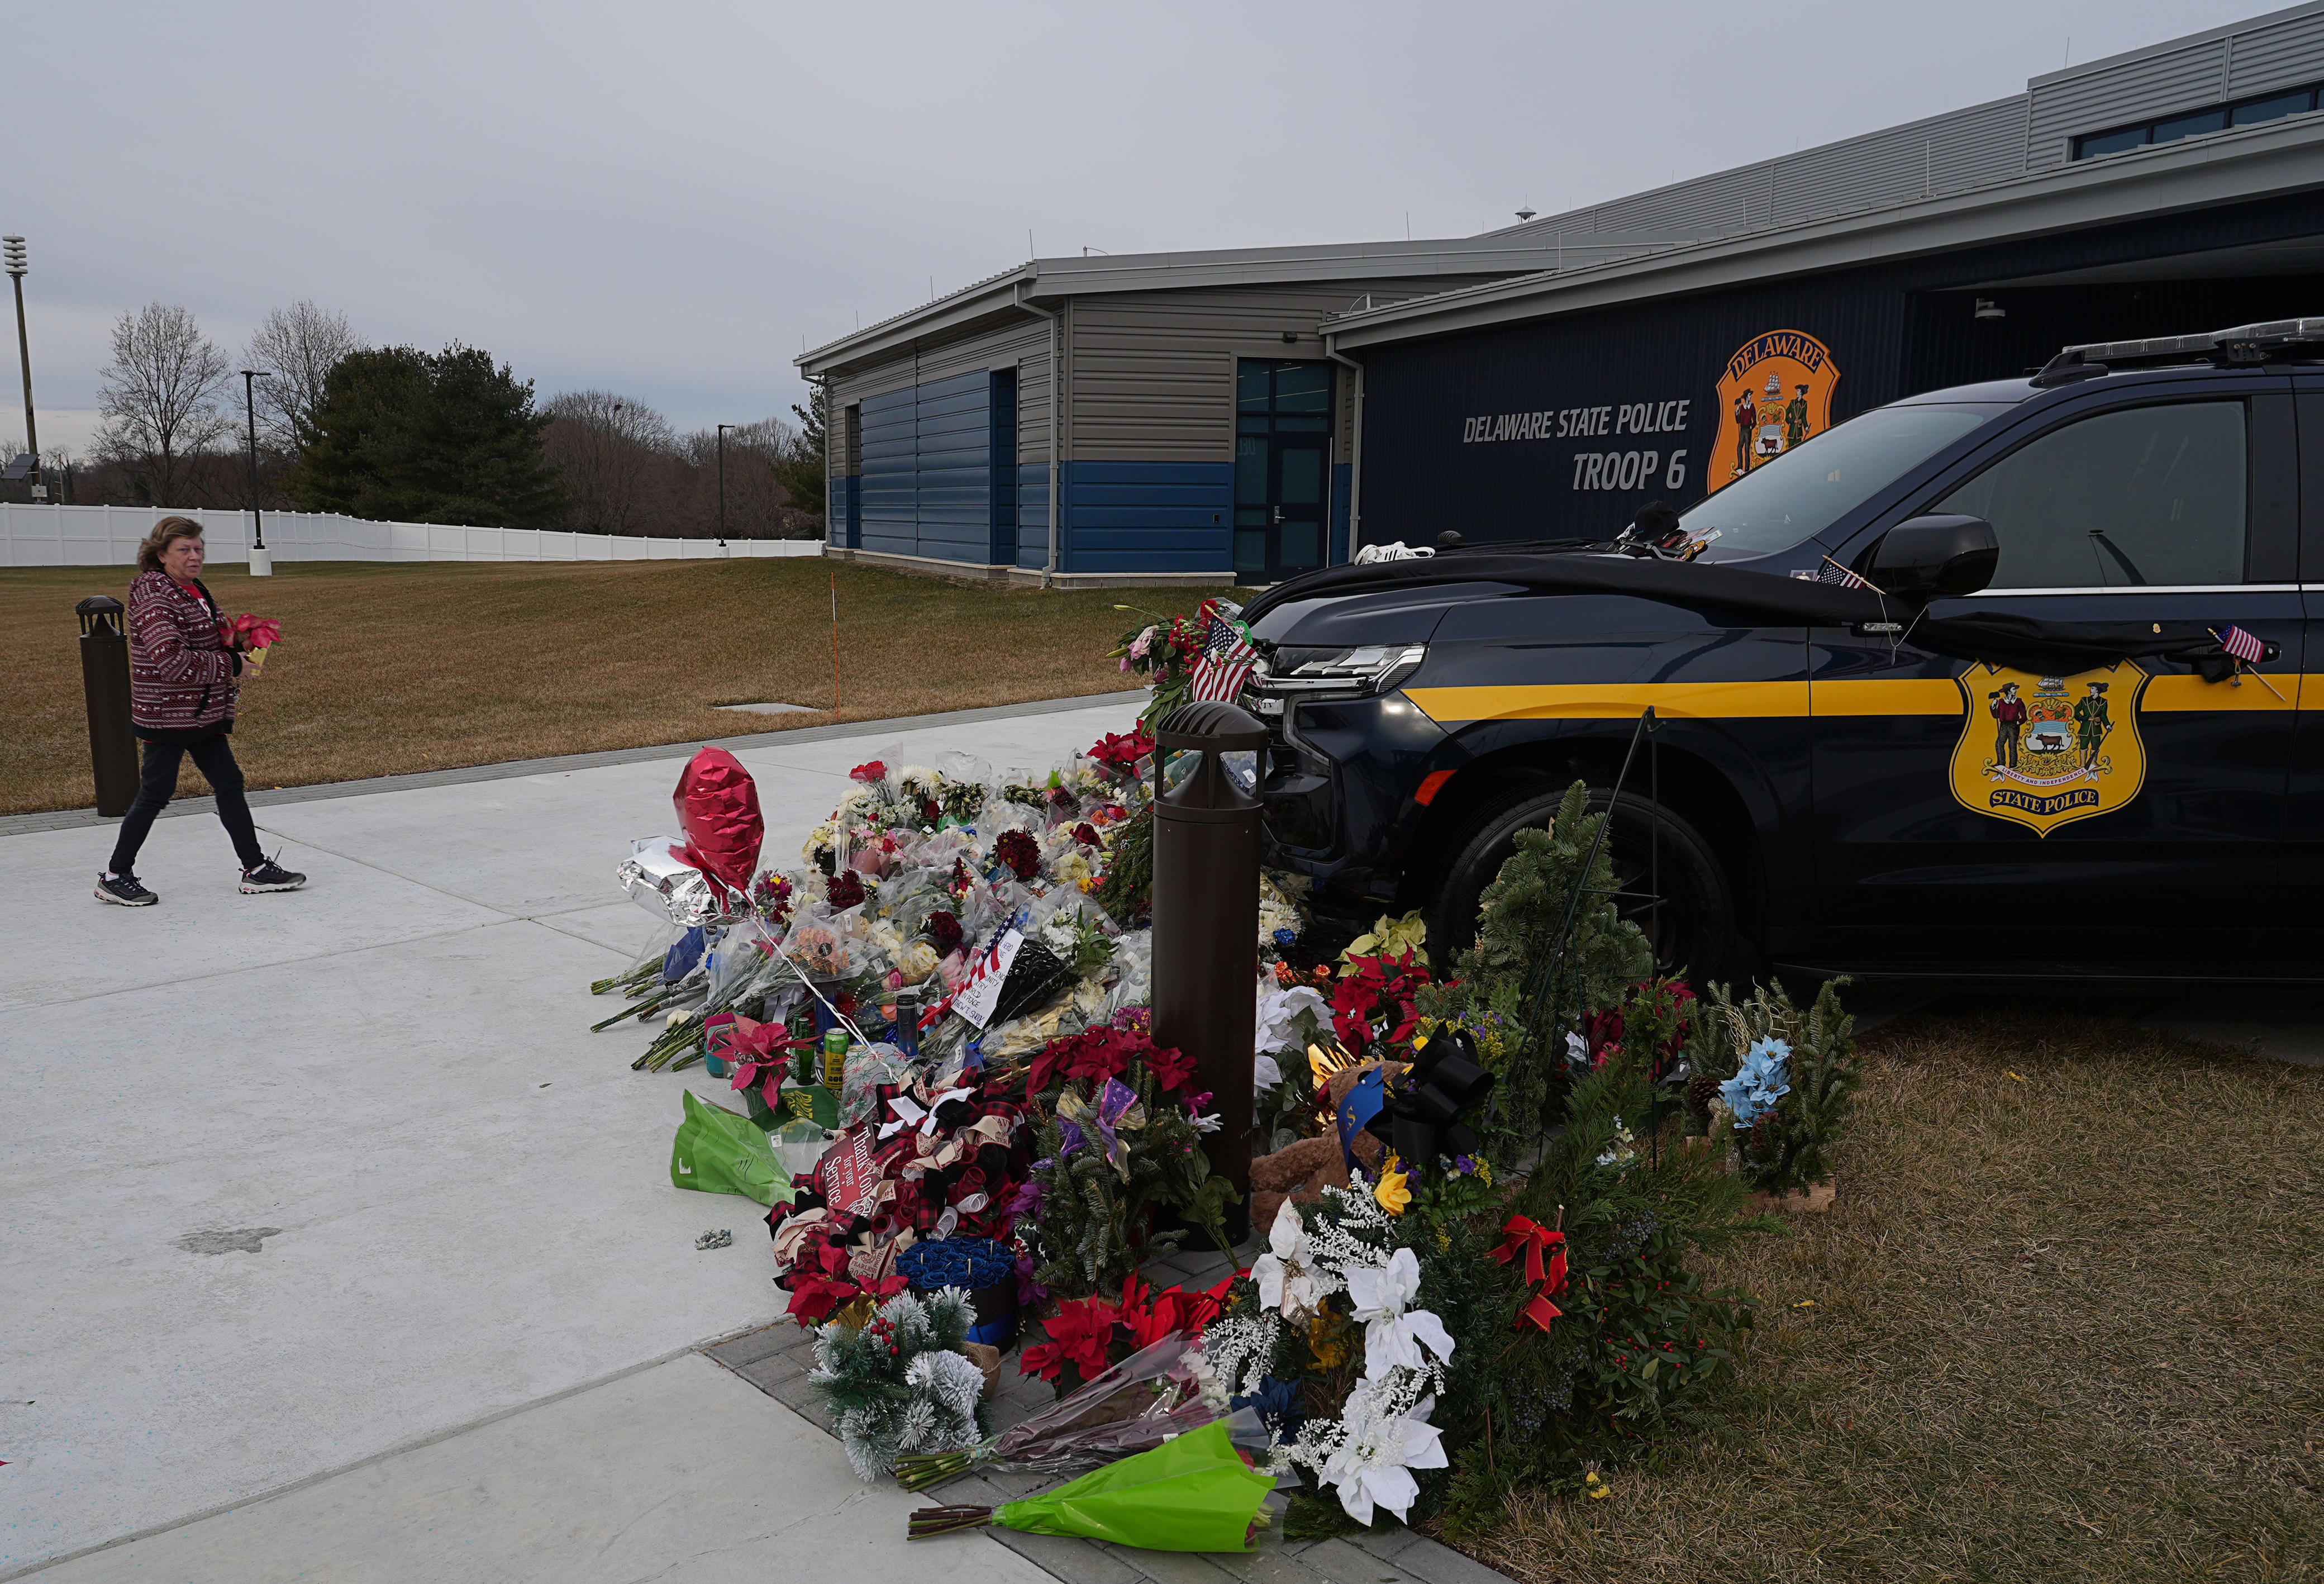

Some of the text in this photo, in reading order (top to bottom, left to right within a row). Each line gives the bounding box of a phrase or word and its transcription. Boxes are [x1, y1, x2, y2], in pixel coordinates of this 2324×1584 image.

[1732, 335, 1823, 379] DELAWARE
[1463, 399, 1690, 443] DELAWARE STATE POLICE
[1573, 449, 1688, 491] TROOP 6
[2002, 767, 2025, 781] LIBERTY
[2040, 769, 2085, 785] INDEPENDENCE
[1992, 791, 2096, 813] STATE POLICE
[1002, 941, 1013, 952] HERO
[966, 995, 981, 1008] PEACE
[853, 1126, 872, 1172] Thank
[825, 1156, 845, 1206] Service
[842, 1155, 854, 1187] for your
[858, 1167, 875, 1197] You
[851, 1260, 877, 1274] FEARLESS
